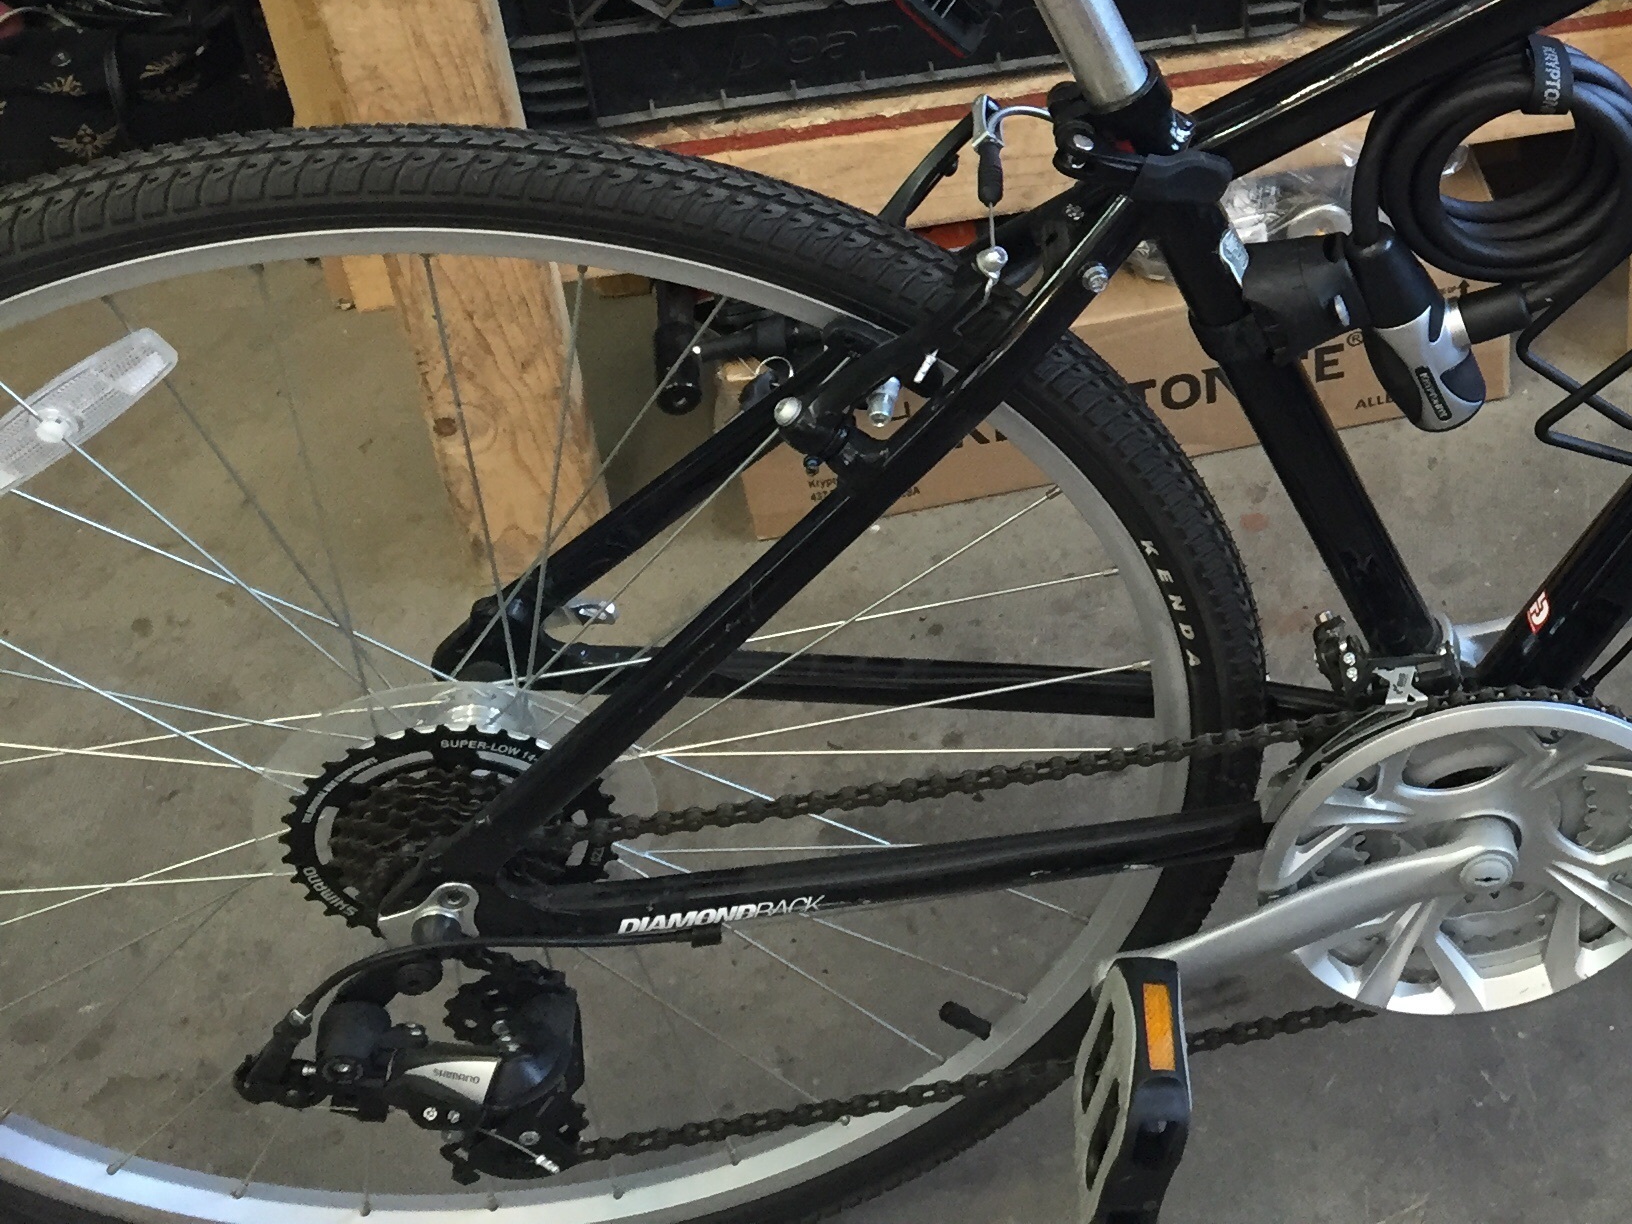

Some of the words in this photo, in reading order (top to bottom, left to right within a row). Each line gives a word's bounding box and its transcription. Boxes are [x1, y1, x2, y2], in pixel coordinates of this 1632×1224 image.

[1140, 540, 1202, 668] KENDA
[440, 738, 520, 756] SUPER-LOW
[301, 865, 360, 918] SHIMANO
[617, 893, 826, 935] DIAMONDBACK
